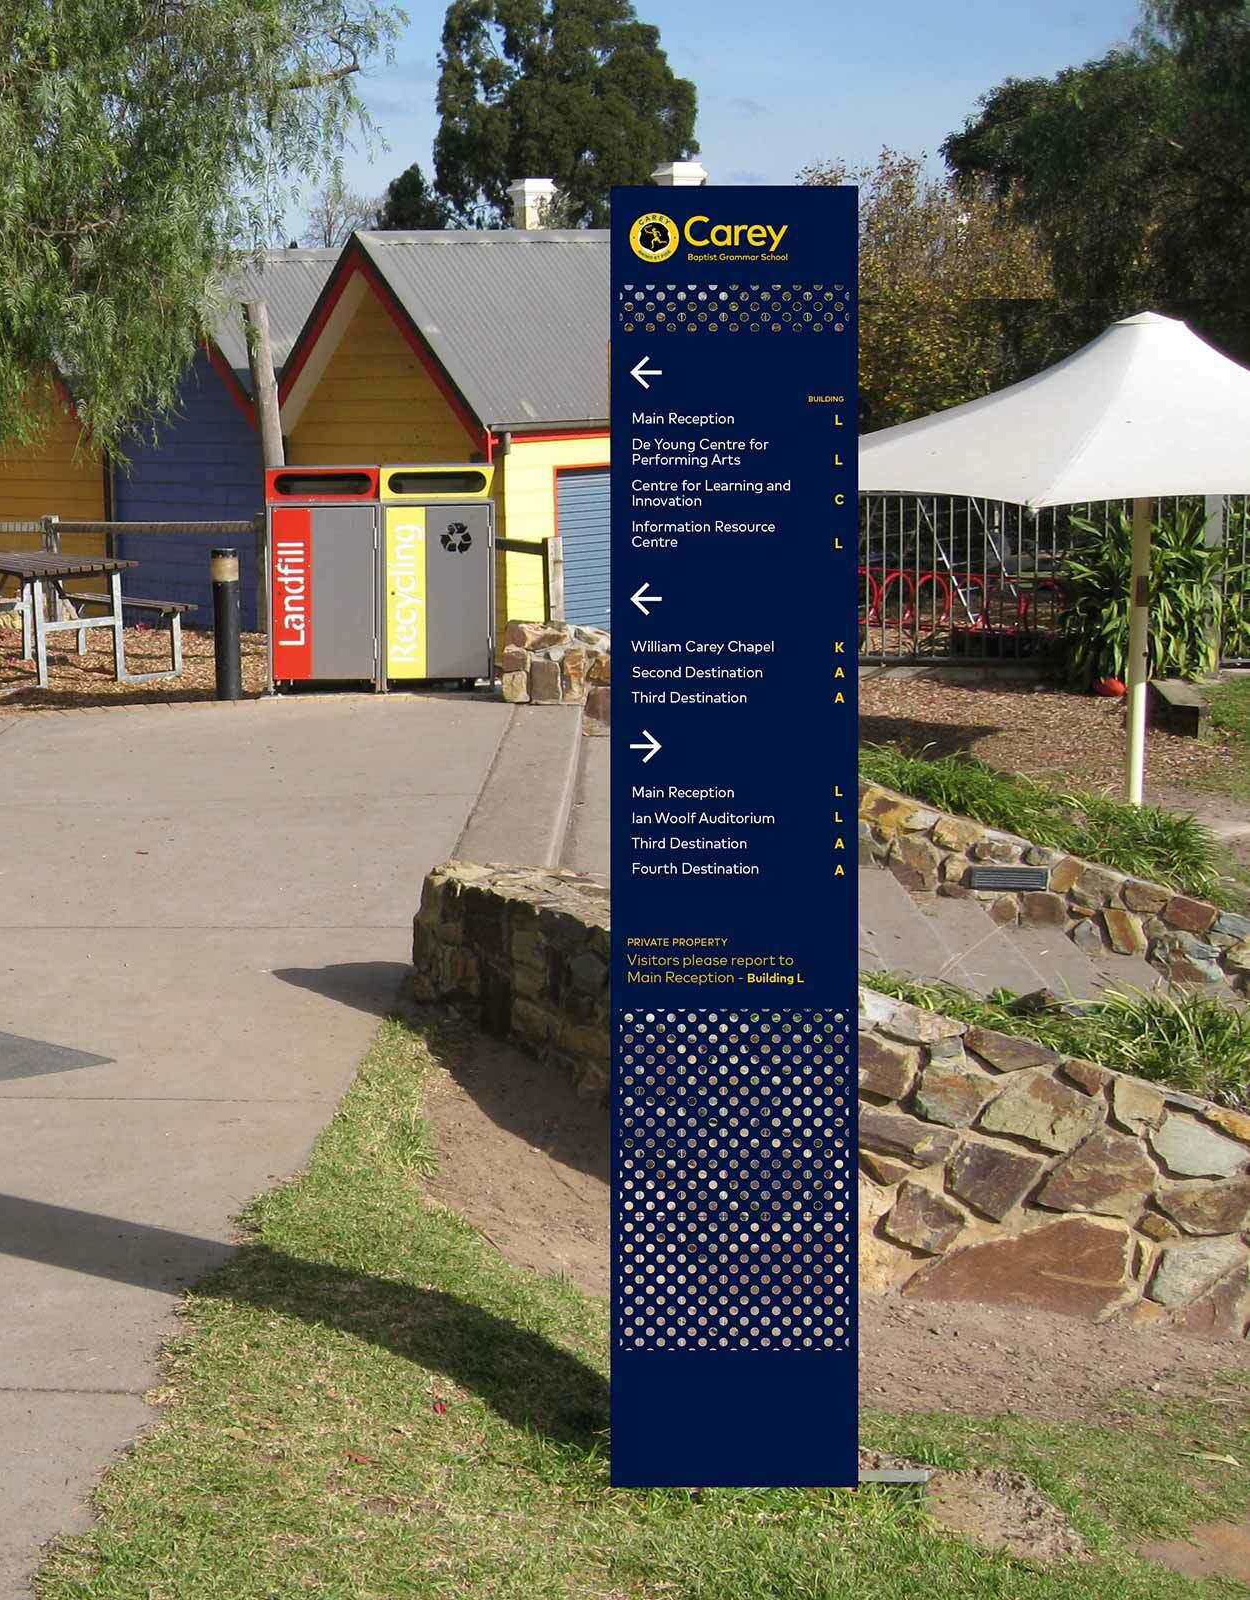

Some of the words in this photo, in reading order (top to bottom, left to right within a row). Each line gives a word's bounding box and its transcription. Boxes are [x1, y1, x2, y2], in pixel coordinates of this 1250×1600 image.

[684, 215, 788, 251] Carey
[687, 253, 717, 262] Baptist
[719, 253, 759, 261] Grammar
[761, 252, 788, 261] School
[808, 395, 845, 403] BUILDING
[632, 412, 664, 425] Main
[668, 412, 735, 427] Reception
[834, 414, 844, 426] L
[632, 438, 650, 450] De
[654, 438, 696, 453] Young
[699, 438, 746, 451] Centre
[748, 437, 769, 451] for
[632, 453, 709, 469] Performing
[711, 453, 741, 466] Arts
[834, 454, 844, 466] L
[632, 479, 679, 492] Centre
[681, 479, 702, 492] for
[705, 479, 763, 494] Learning
[766, 479, 791, 492] and
[632, 494, 702, 507] Innovation
[834, 493, 845, 505] C
[632, 520, 711, 533] Information
[714, 520, 776, 533] Resource
[631, 535, 679, 548] Centre
[834, 537, 844, 549] L
[277, 541, 306, 647] Landfill
[391, 524, 423, 663] Recycling
[631, 640, 682, 653] William
[685, 640, 725, 656] Carey
[727, 640, 775, 655] Chapel
[834, 641, 845, 653] K
[632, 666, 682, 679] Second
[685, 665, 764, 679] Destination
[834, 666, 845, 679] A
[631, 691, 666, 704] Third
[669, 691, 748, 704] Destination
[834, 691, 845, 704] A
[632, 785, 665, 799] Main
[668, 785, 735, 801] Reception
[834, 785, 844, 797] L
[632, 811, 652, 825] Ian
[654, 811, 697, 825] Woolf
[698, 811, 775, 825] Auditorium
[834, 811, 844, 823] L
[631, 836, 666, 850] Third
[669, 836, 748, 850] Destination
[834, 837, 845, 850] A
[632, 862, 678, 875] Fourth
[681, 862, 760, 875] Destination
[834, 864, 845, 876] A
[627, 937, 670, 947] PRIVATE
[672, 937, 728, 947] PROPERTY
[627, 953, 680, 966] Visitors
[682, 953, 728, 969] please
[731, 955, 776, 969] report
[778, 955, 794, 966] to
[627, 971, 662, 983] Main
[665, 971, 735, 986] Reception
[747, 971, 794, 985] Building
[796, 972, 805, 984] L
